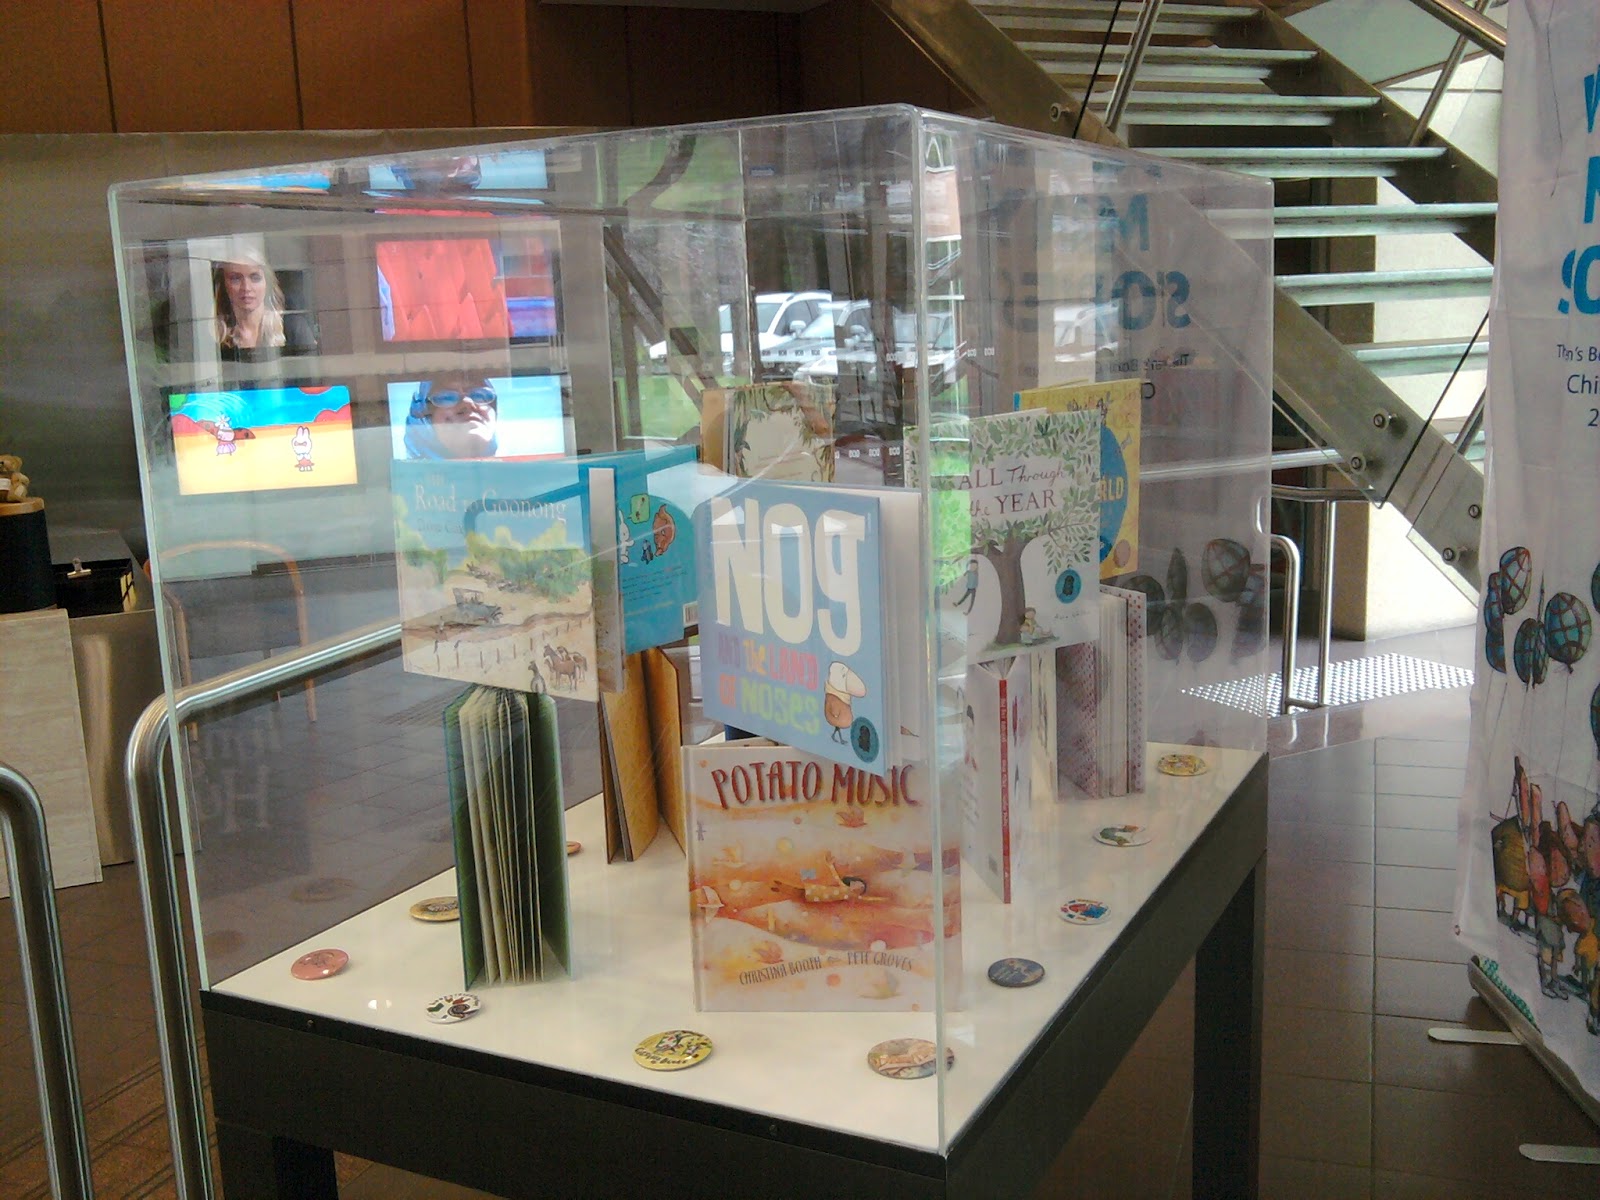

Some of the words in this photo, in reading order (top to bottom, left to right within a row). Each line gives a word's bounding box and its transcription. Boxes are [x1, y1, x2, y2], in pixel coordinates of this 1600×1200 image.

[958, 467, 1003, 491] ALL
[1006, 463, 1064, 488] Through
[1097, 476, 1125, 501] RLD
[993, 489, 1057, 515] YEAR
[711, 760, 821, 810] POTATO
[830, 763, 920, 807] MUSIC
[739, 963, 787, 985] CHRISTINA
[789, 956, 822, 976] BOOTH
[873, 951, 912, 971] GROVES
